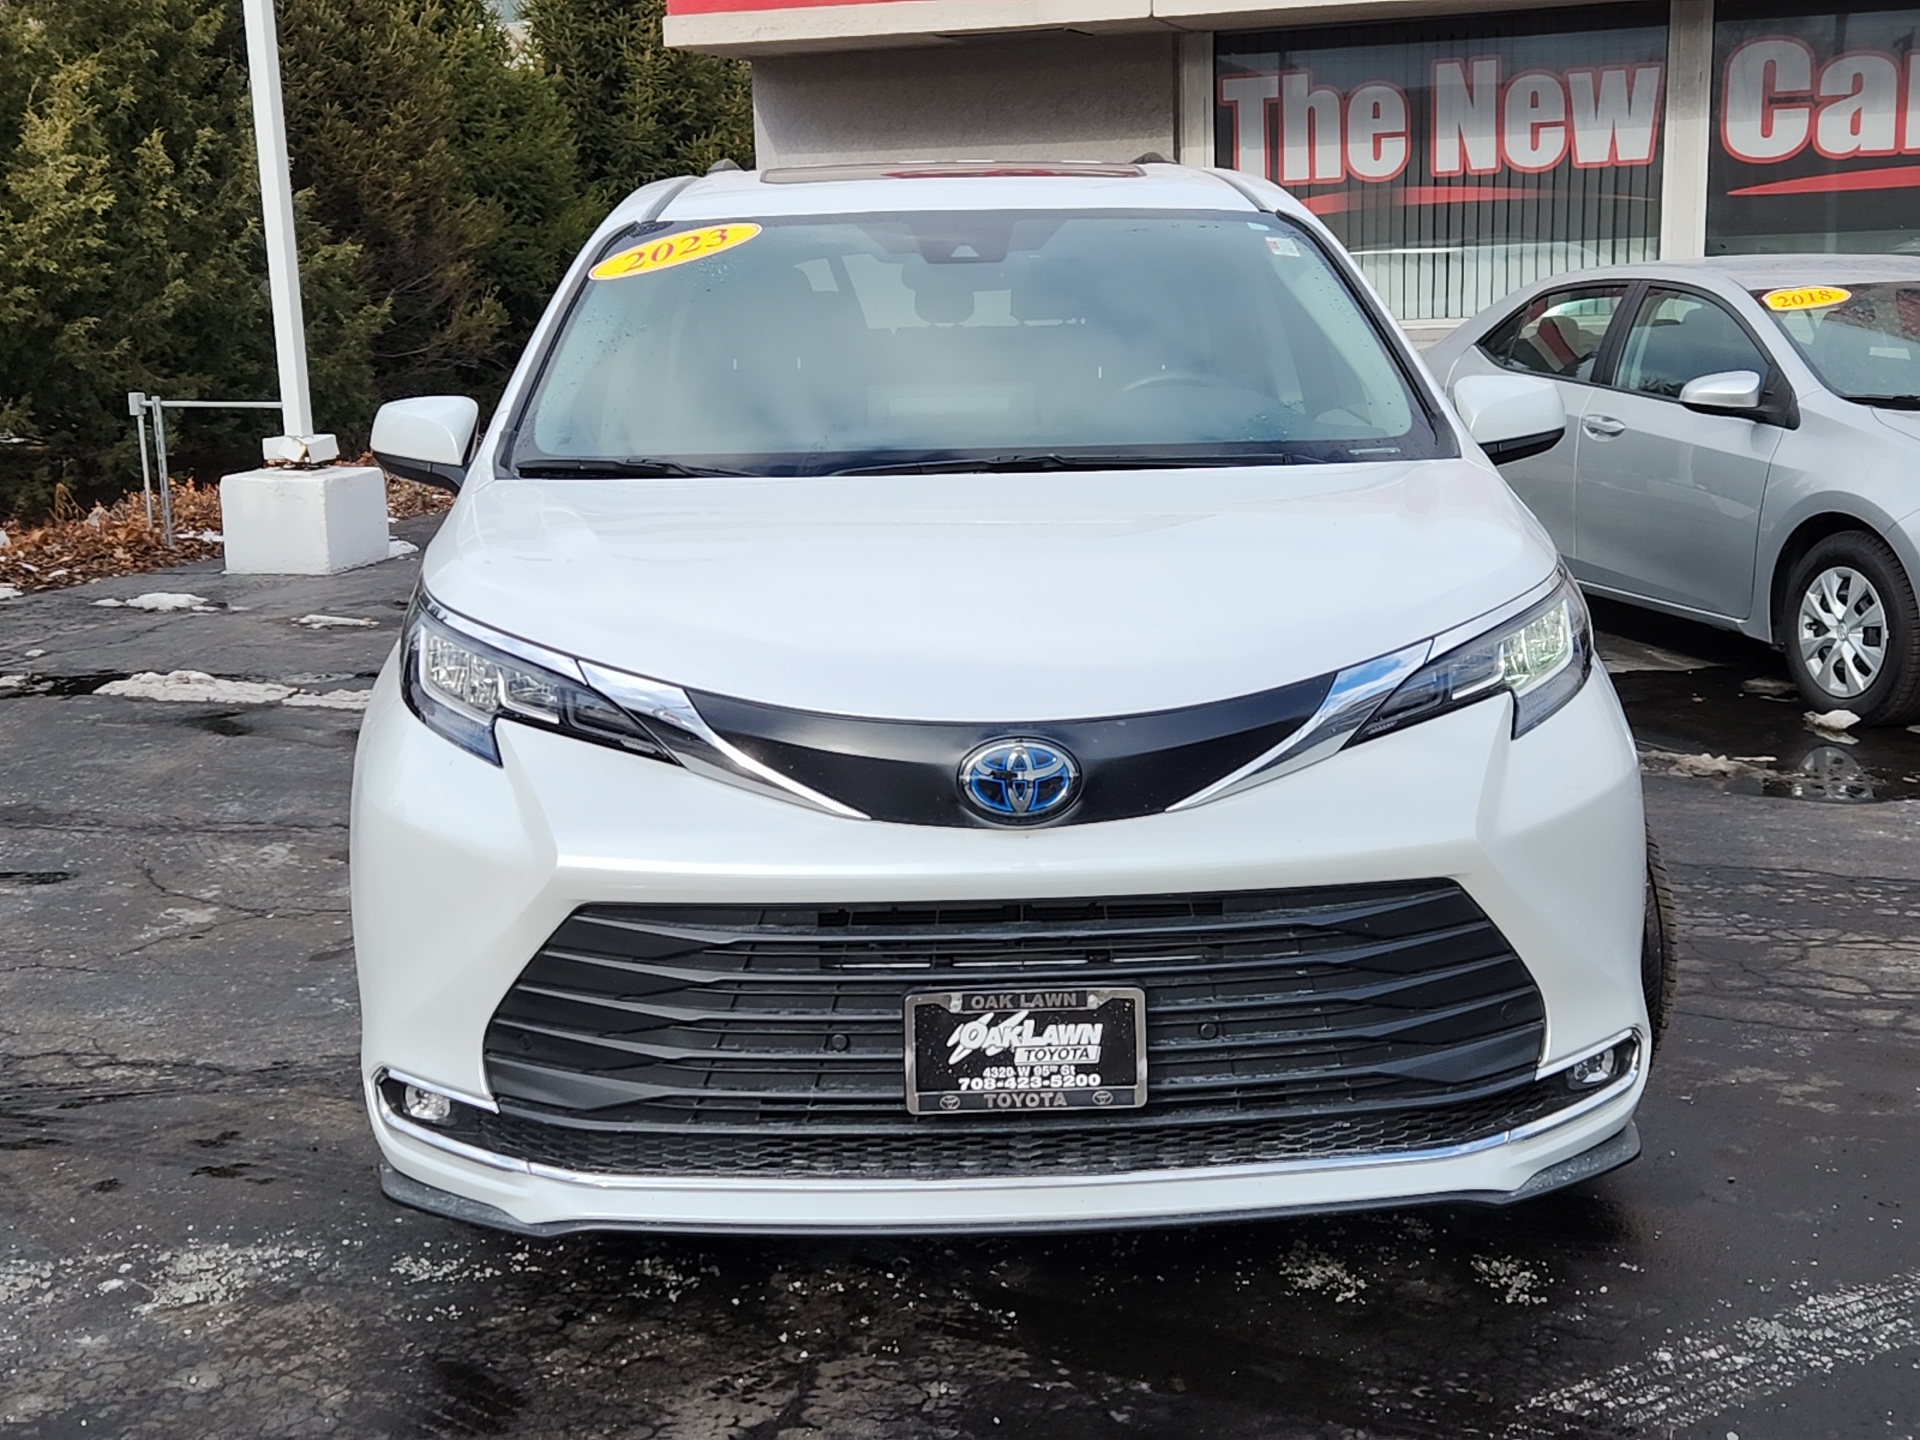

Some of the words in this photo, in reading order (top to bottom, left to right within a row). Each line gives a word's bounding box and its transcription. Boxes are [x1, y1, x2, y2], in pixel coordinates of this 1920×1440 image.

[1219, 70, 1411, 186] The
[1431, 55, 1664, 177] New
[622, 228, 728, 273] 2023
[1776, 290, 1832, 307] 2018
[970, 995, 1013, 1009] OAK
[1019, 993, 1077, 1008] LAWN
[1024, 1047, 1090, 1061] TOYOTA
[982, 1066, 1017, 1079] 4320
[1017, 1066, 1031, 1077] W
[1060, 1064, 1076, 1076] St
[958, 1073, 1101, 1091] 708-423-5200
[983, 1092, 1068, 1108] TOYOTA
